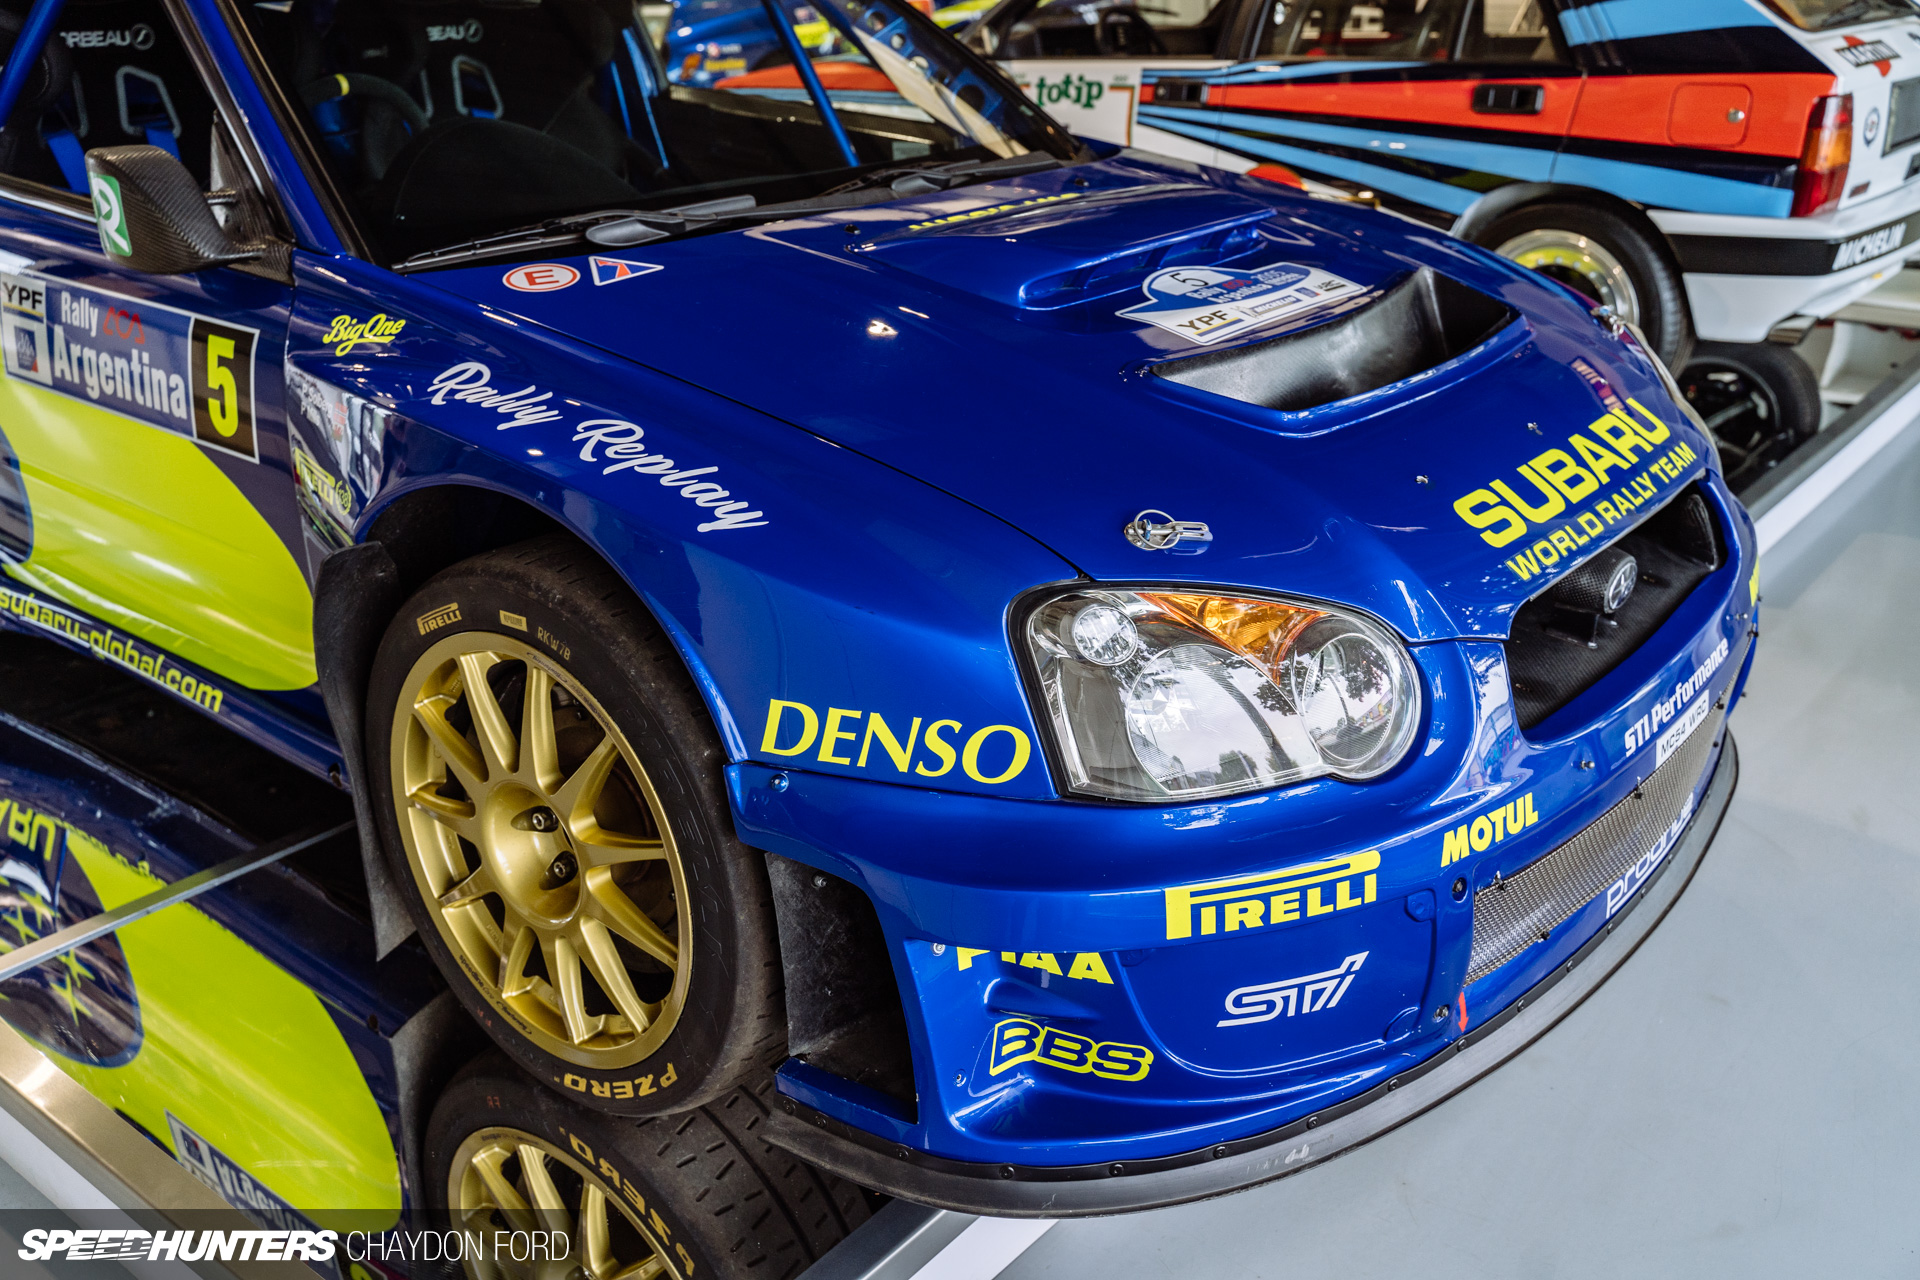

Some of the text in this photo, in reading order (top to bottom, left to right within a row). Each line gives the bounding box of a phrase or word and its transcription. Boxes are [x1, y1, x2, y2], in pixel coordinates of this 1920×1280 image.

[60, 30, 131, 48] RBEAU
[1035, 73, 1104, 109] totip
[1832, 221, 1907, 271] MICHELIN
[3, 282, 43, 310] YPF
[523, 268, 561, 287] E
[1169, 272, 1210, 288] 5
[1253, 295, 1298, 313] MICHELIN
[60, 290, 98, 338] Rally
[1176, 310, 1232, 331] YPF
[53, 323, 188, 421] Argentina
[207, 334, 239, 438] 5
[427, 361, 770, 533] Rally Replay
[1453, 397, 1671, 548] SUBARU
[1506, 440, 1697, 581] WORLD RALLY TEAM
[416, 602, 463, 636] PIRELLI
[1624, 637, 1729, 758] STI Performance
[760, 698, 1031, 784] DENSO
[1441, 792, 1539, 867] MOTUL
[1165, 849, 1381, 940] PIRELLI
[989, 1018, 1155, 1082] BBS
